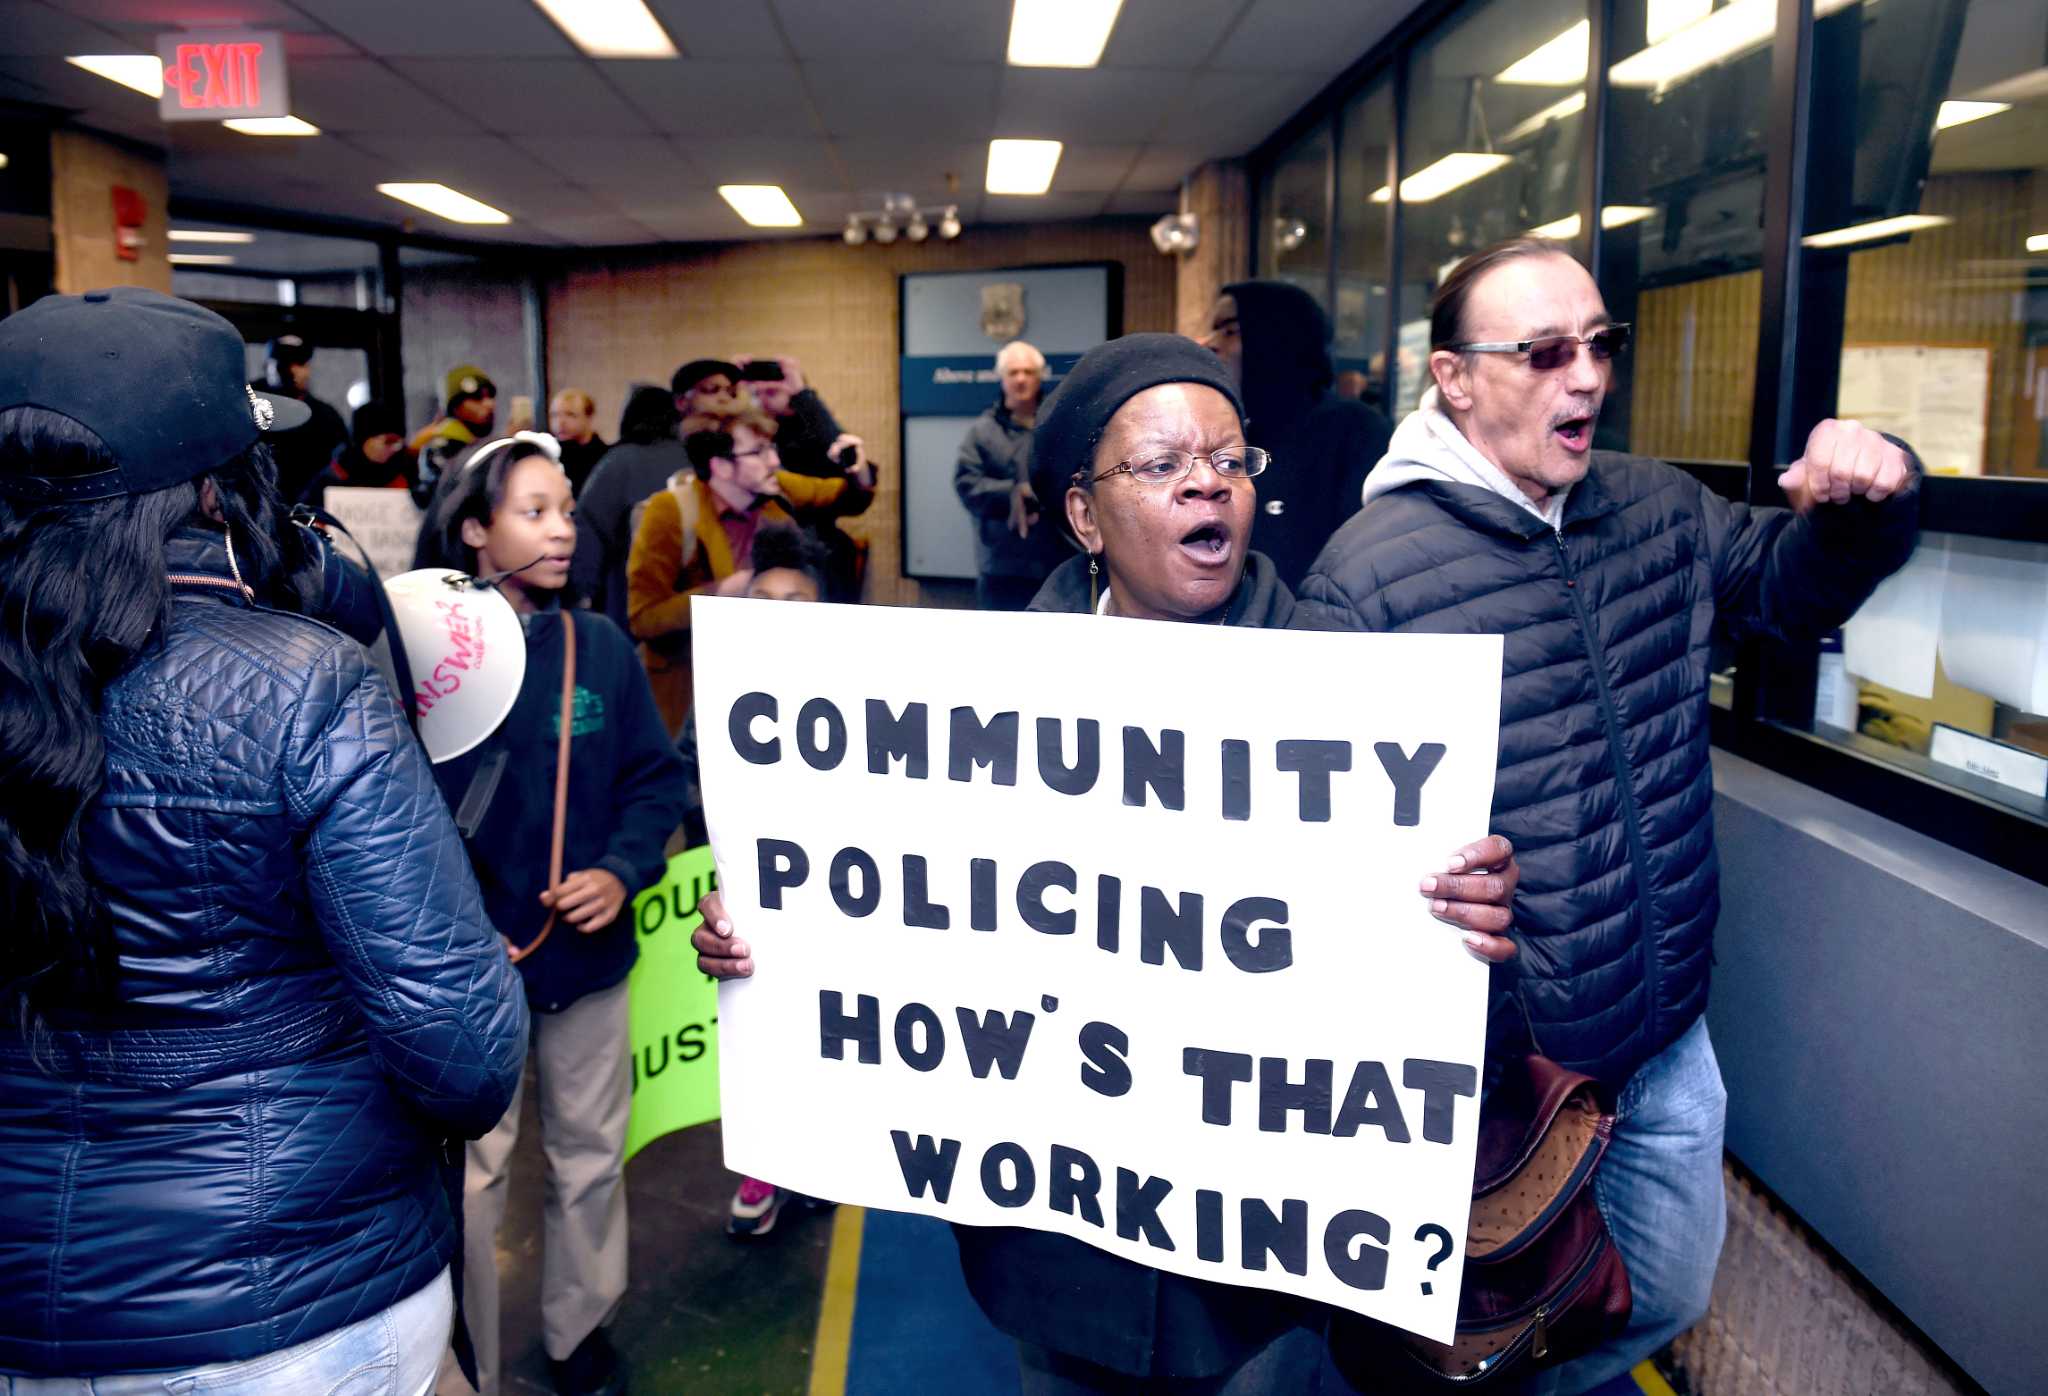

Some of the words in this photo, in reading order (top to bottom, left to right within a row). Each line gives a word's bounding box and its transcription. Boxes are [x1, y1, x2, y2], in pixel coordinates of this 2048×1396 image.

[176, 42, 264, 109] EXIT
[728, 691, 1447, 827] COMMUNITY
[756, 837, 1293, 974] POLICING
[631, 1016, 718, 1098] JUS
[819, 989, 1133, 1098] HOW'S
[1182, 1046, 1478, 1145] THAT
[889, 1129, 1455, 1297] WORKING?
